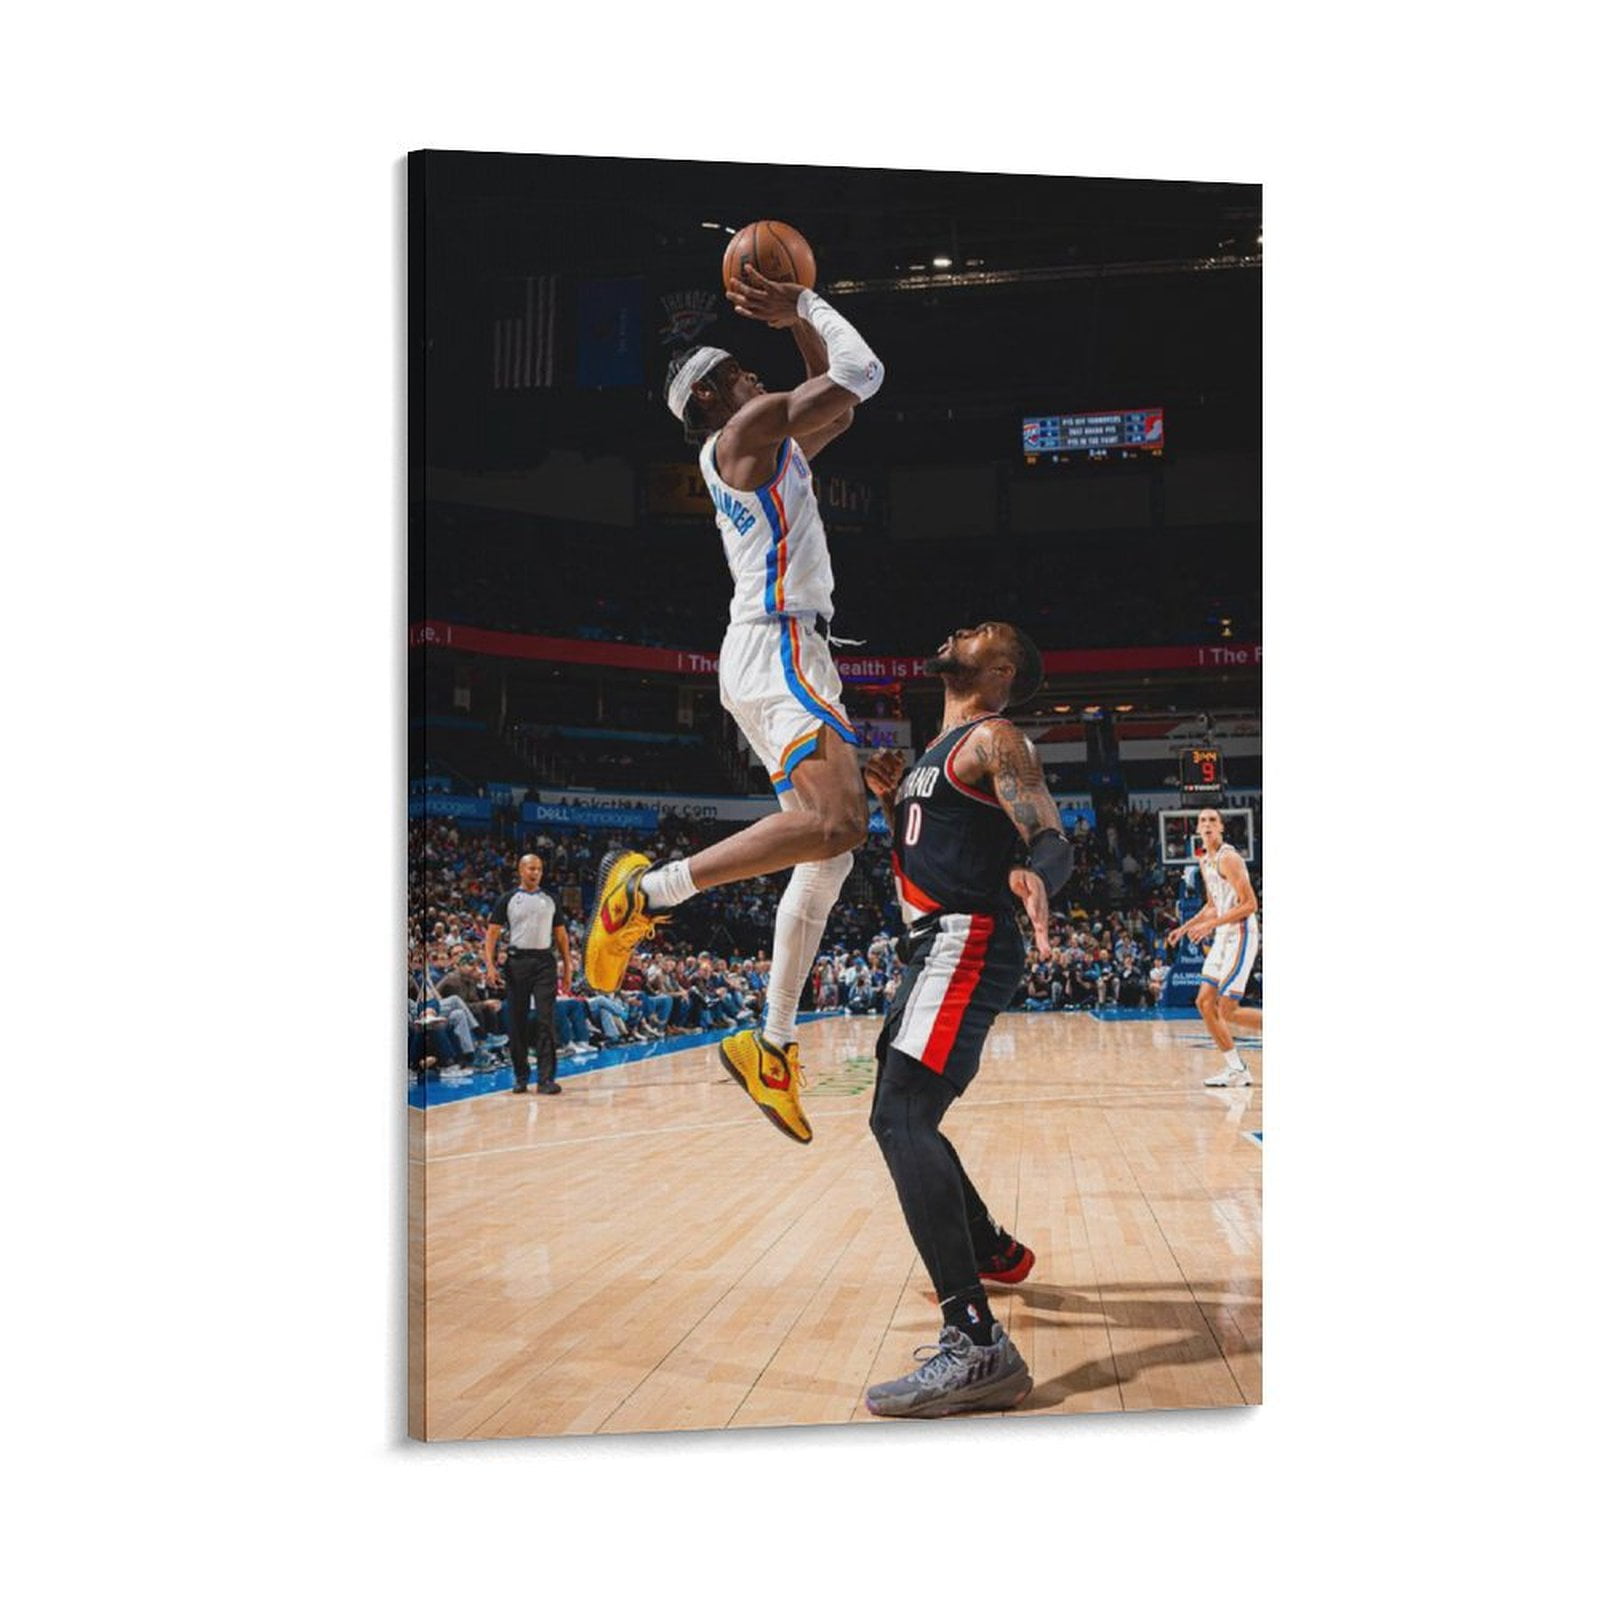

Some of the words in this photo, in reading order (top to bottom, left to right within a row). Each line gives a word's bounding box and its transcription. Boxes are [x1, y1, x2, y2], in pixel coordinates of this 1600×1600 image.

[1210, 648, 1247, 664] The
[837, 659, 886, 677] ealth
[892, 661, 907, 677] is
[905, 802, 923, 847] 0
